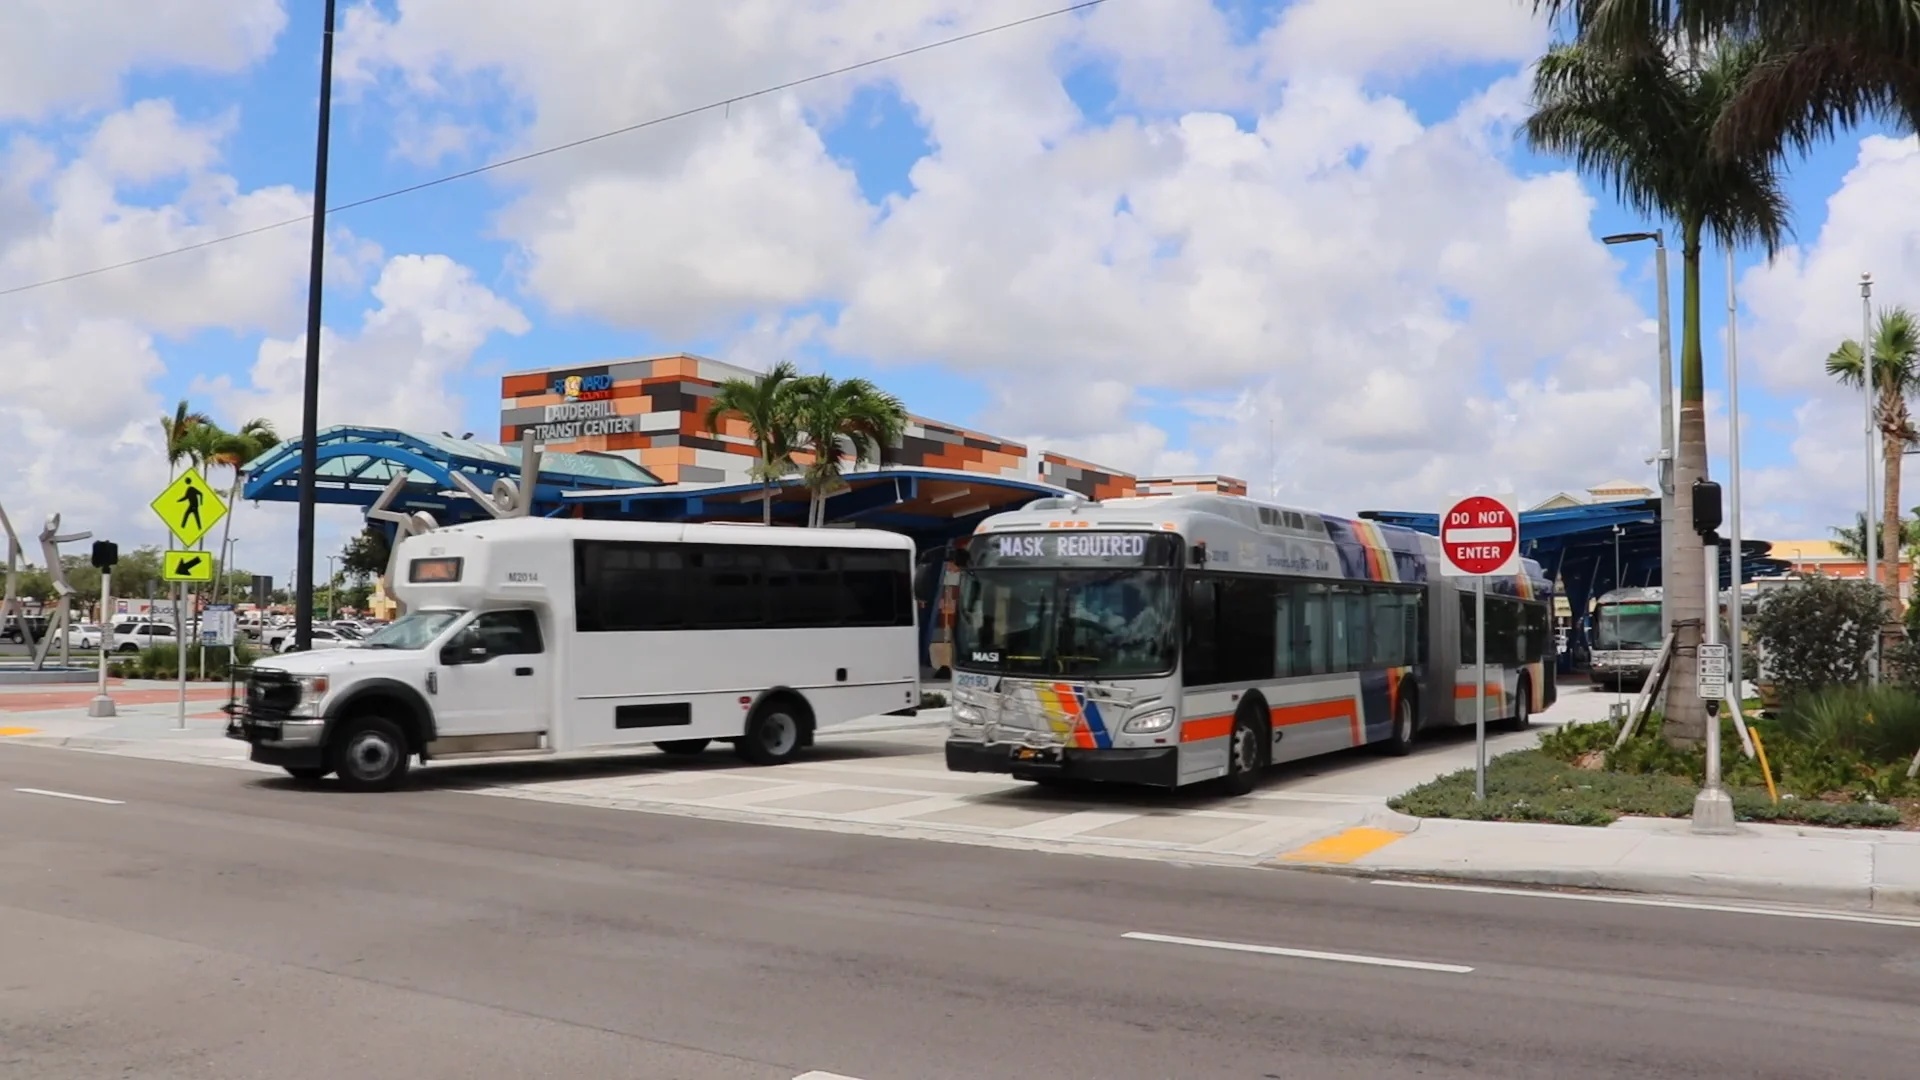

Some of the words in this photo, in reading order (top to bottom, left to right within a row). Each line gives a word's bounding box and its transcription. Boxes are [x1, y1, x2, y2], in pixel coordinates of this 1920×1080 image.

[546, 401, 616, 422] LAUDERHILL
[535, 421, 582, 439] TRANSIT
[583, 418, 632, 436] CENTER
[1451, 512, 1470, 525] DO
[1478, 510, 1505, 524] NOT
[1000, 536, 1044, 556] MASK
[1057, 535, 1144, 556] REQUIRED
[1457, 546, 1501, 560] ENTER
[508, 572, 538, 582] M2014
